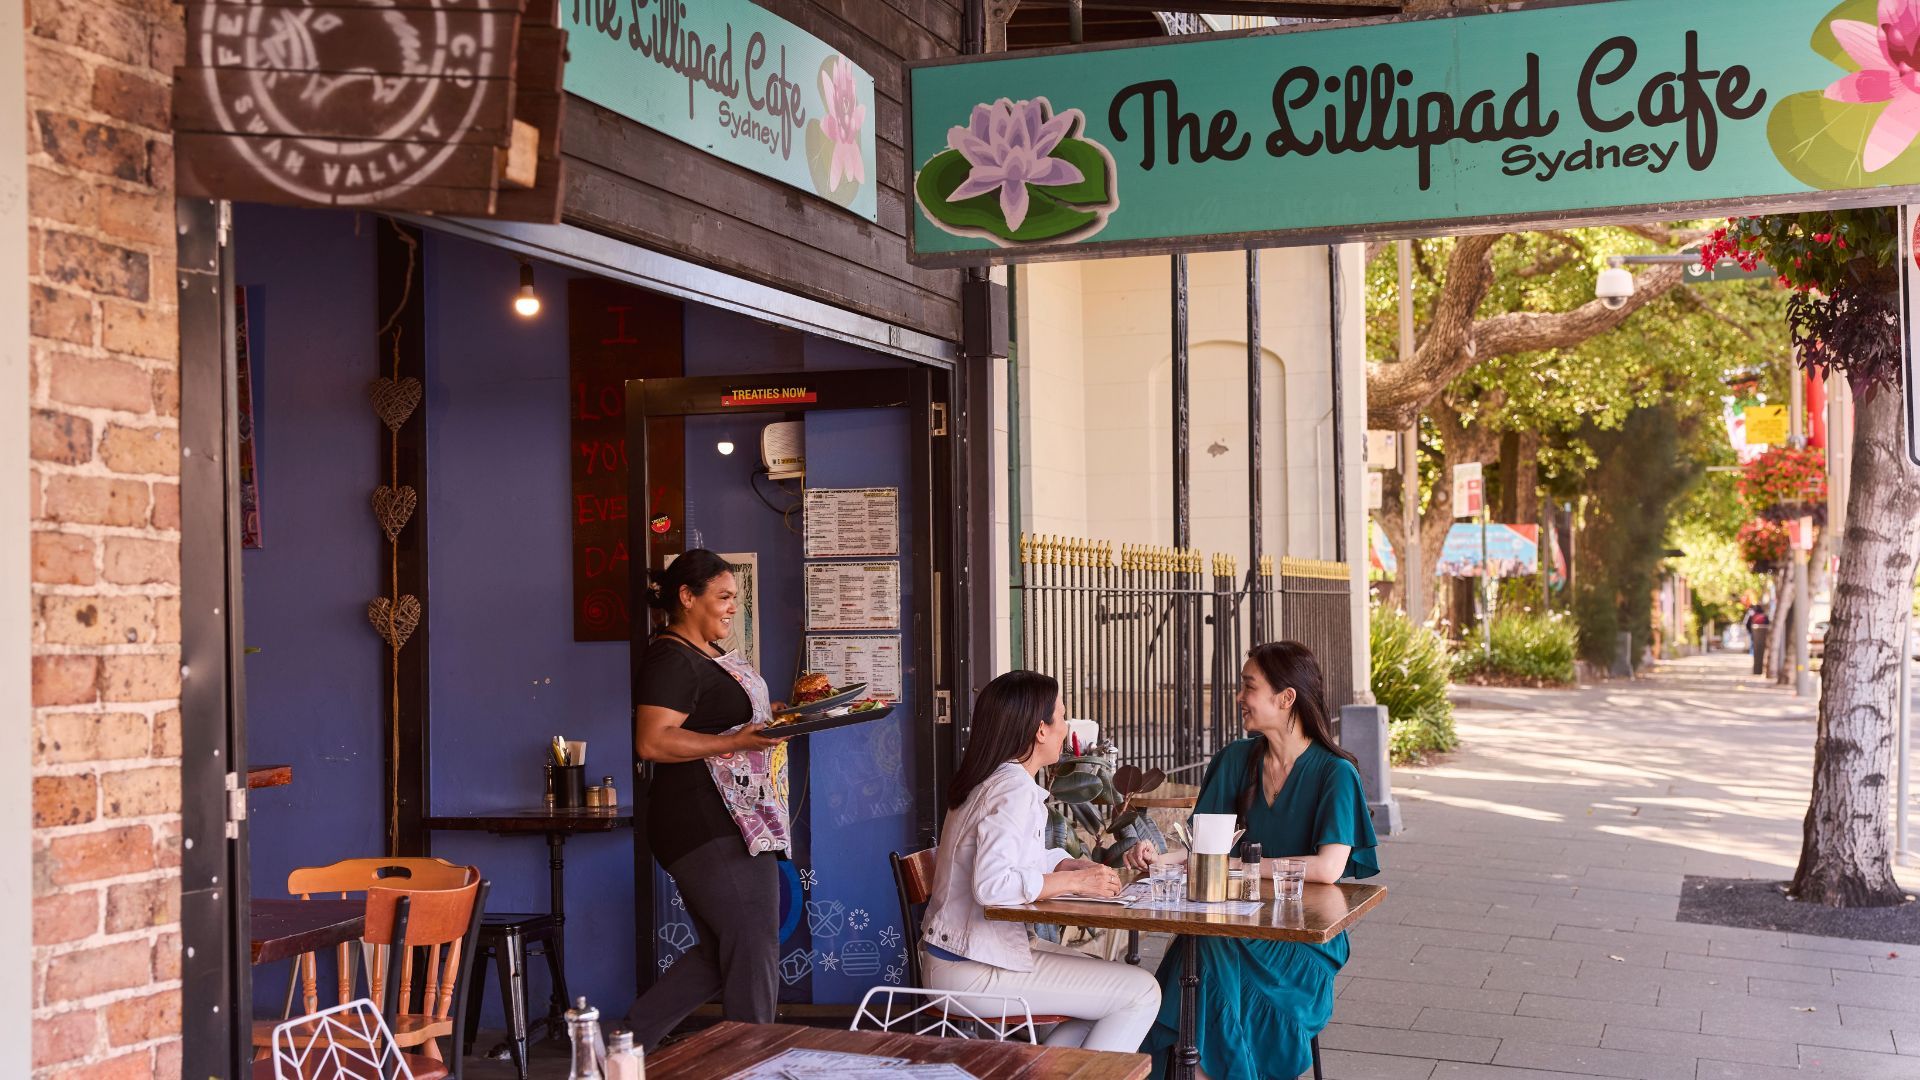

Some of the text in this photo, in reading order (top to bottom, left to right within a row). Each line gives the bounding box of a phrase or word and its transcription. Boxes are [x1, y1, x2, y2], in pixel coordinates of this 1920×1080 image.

[218, 0, 245, 66] FE
[628, 0, 739, 120] Lillipad
[745, 31, 805, 161] Cafe
[719, 100, 779, 154] Sydney
[1108, 30, 1767, 191] The Lillipad Cafe
[234, 95, 441, 187] SWAN VALLEY
[1502, 138, 1679, 182] Sydney
[602, 306, 637, 344] I
[578, 383, 624, 421] LO
[732, 387, 807, 401] TREATIES NOW
[580, 438, 628, 476] YO
[584, 541, 630, 578] DA
